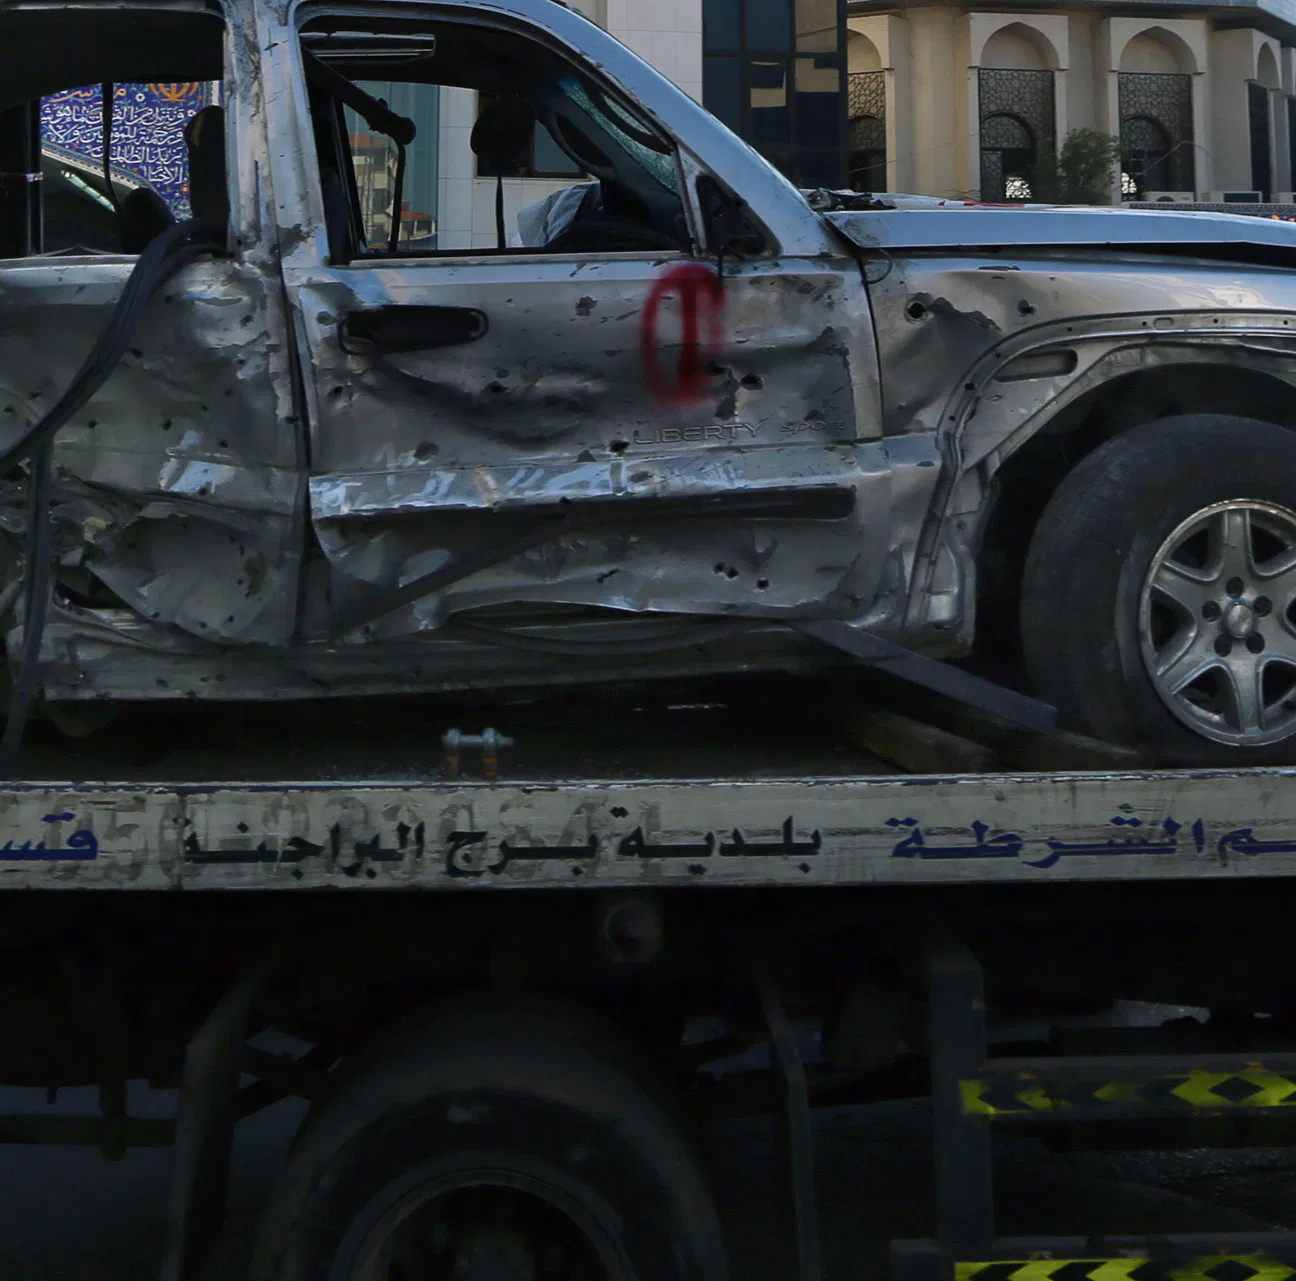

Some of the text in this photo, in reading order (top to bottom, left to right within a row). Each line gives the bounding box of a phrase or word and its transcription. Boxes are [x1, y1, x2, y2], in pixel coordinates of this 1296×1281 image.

[633, 422, 762, 445] LIBERTY
[172, 816, 426, 880] البراجنة
[445, 824, 599, 879] برج
[610, 805, 823, 875] بلدية
[885, 802, 1205, 870] الشرطة
